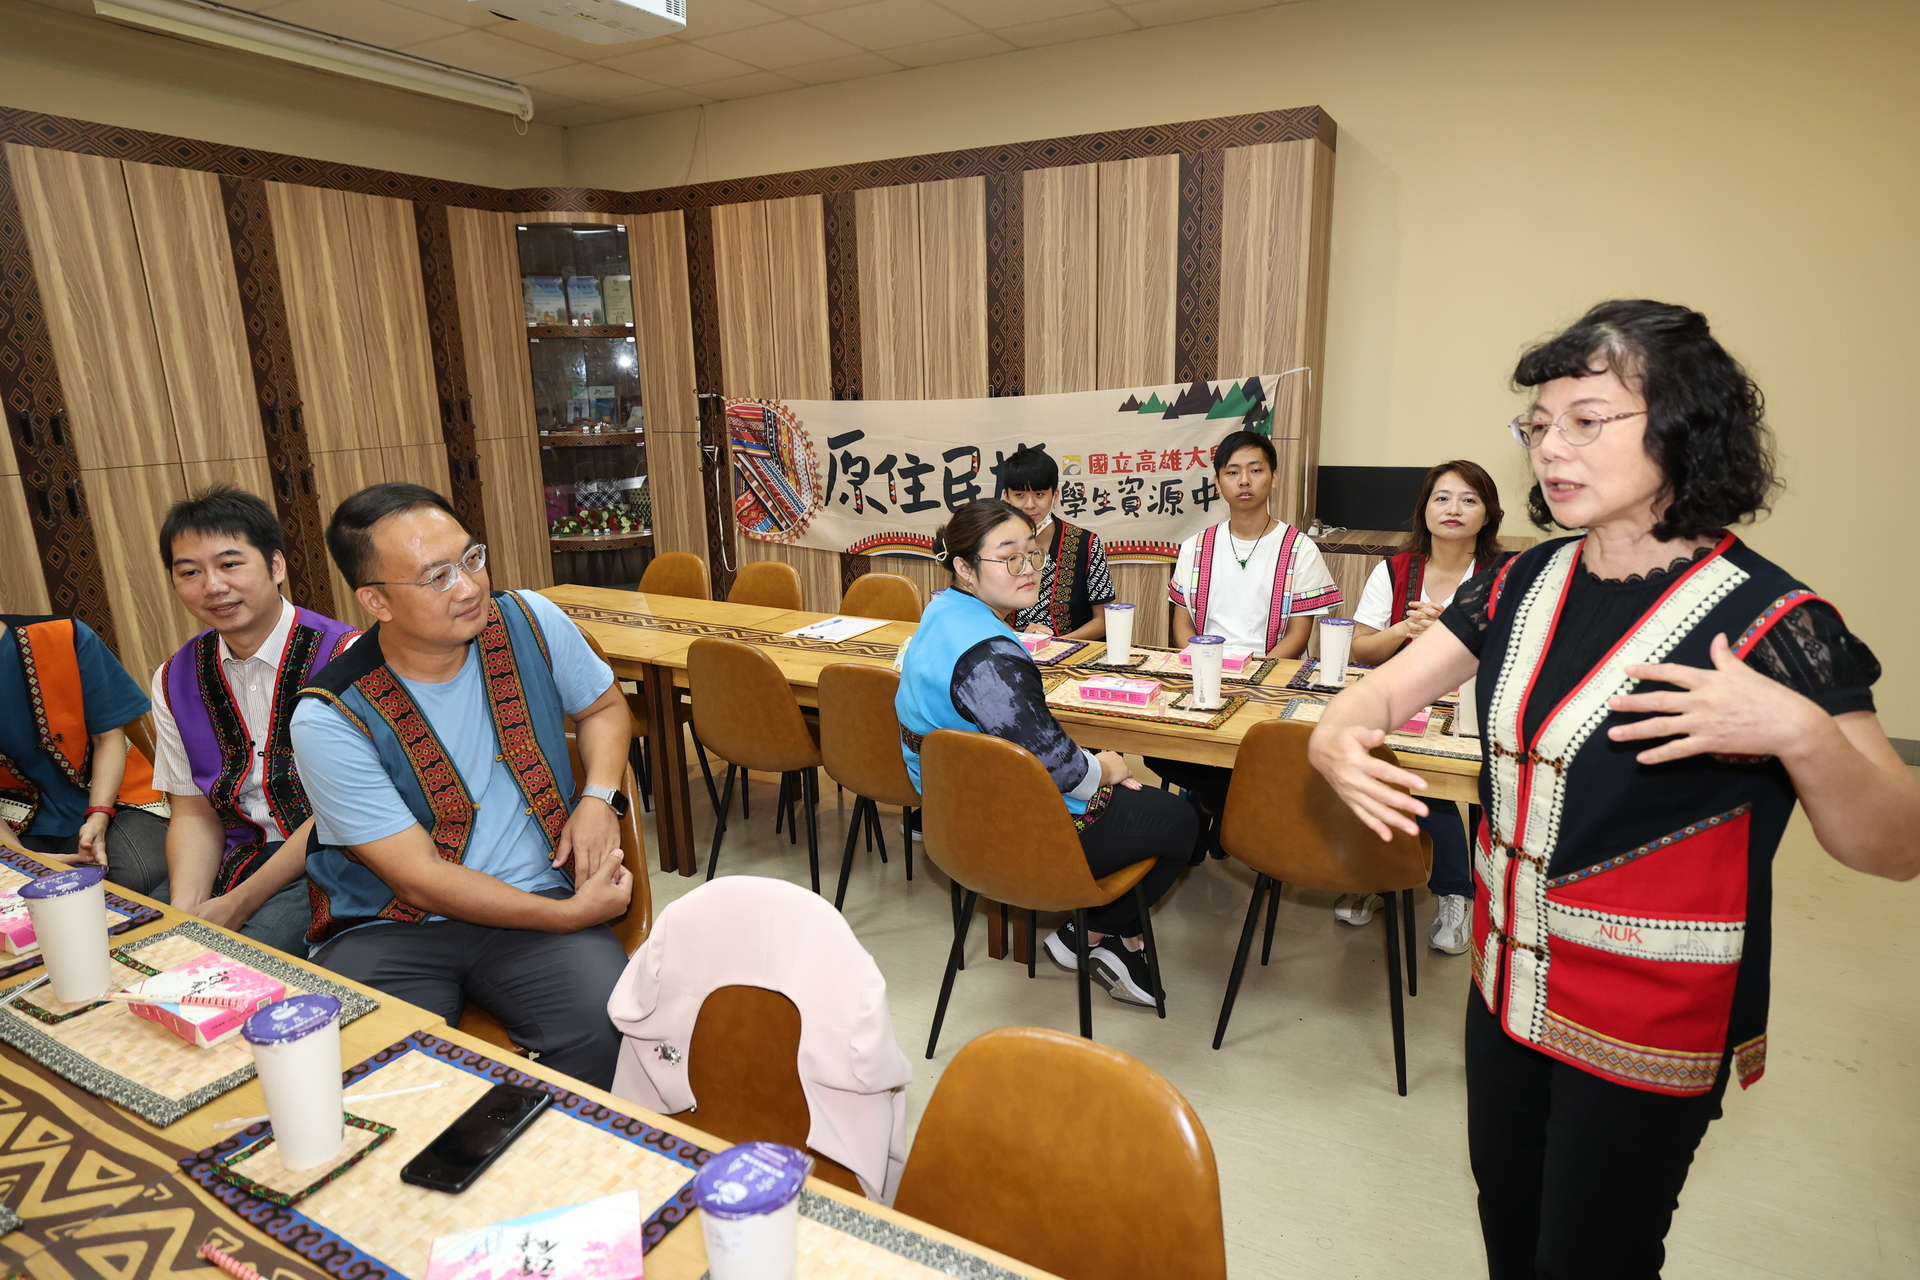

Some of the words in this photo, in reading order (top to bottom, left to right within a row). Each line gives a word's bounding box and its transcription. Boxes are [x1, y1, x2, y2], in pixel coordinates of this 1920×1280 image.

[825, 429, 1046, 514] 原住民
[1060, 476, 1220, 518] 學生資源中
[1600, 924, 1643, 943] NUK
